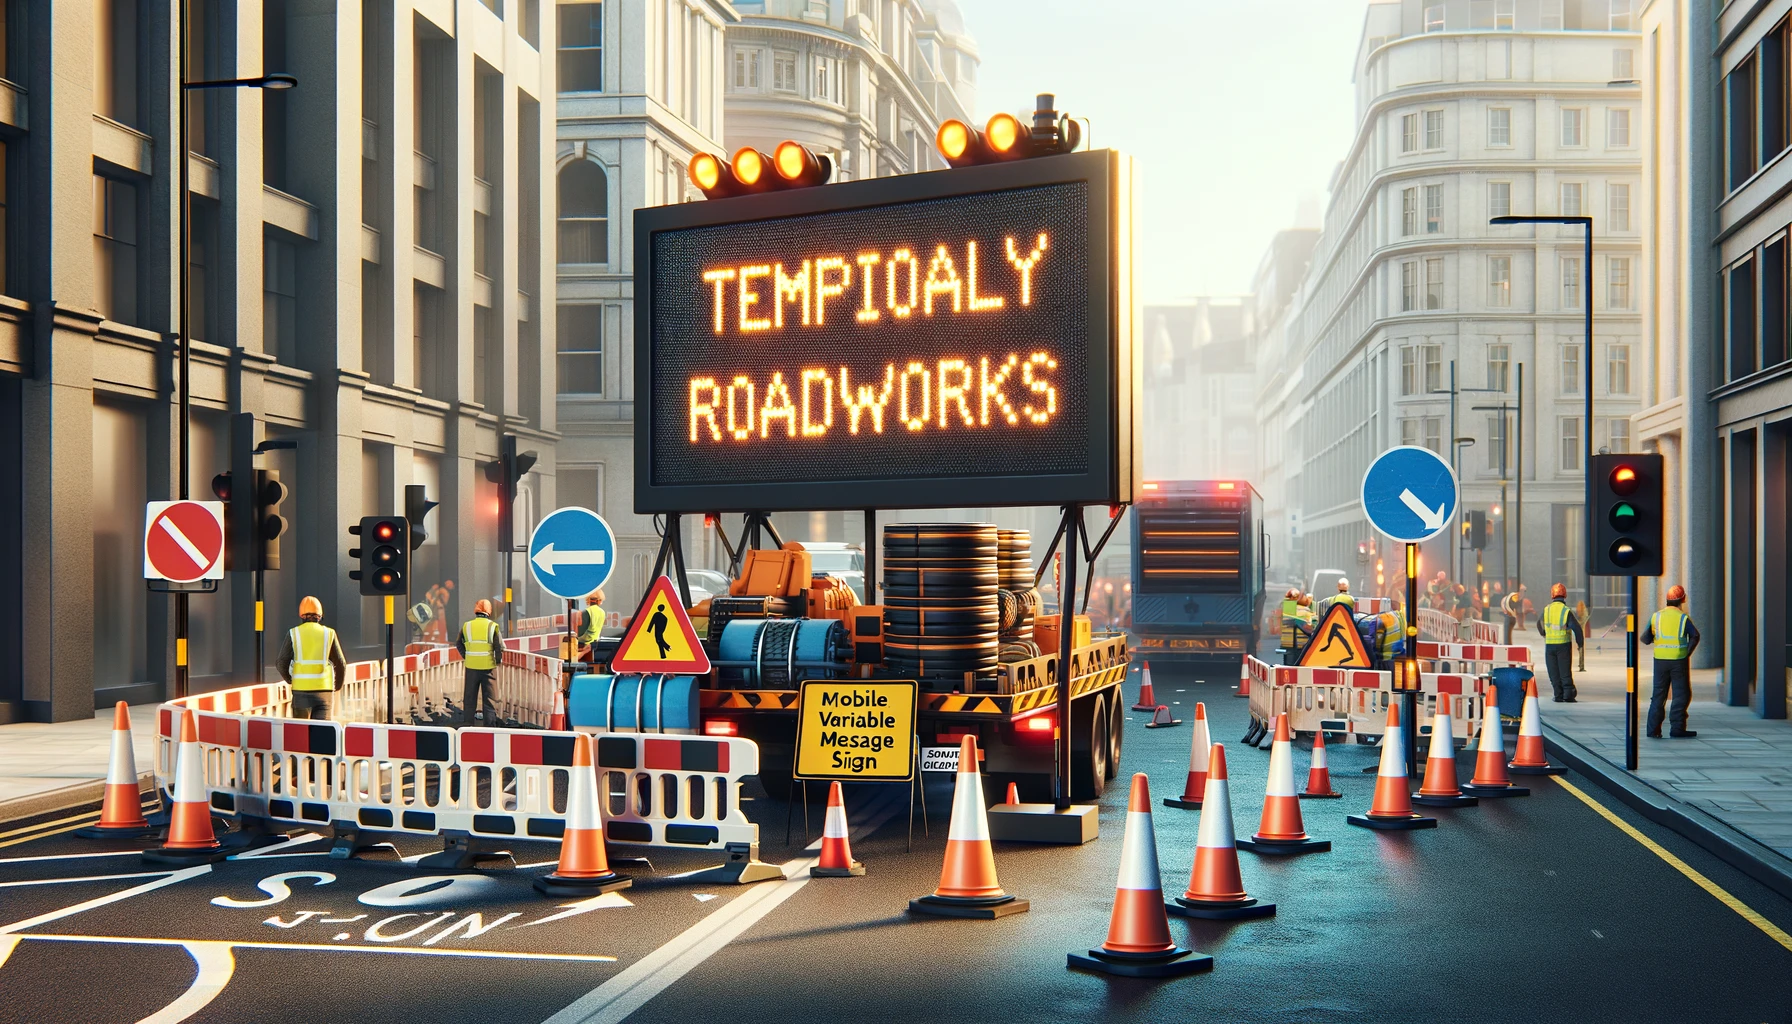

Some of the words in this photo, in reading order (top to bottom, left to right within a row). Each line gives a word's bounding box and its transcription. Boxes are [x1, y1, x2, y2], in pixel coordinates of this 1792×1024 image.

[702, 230, 1050, 335] TEMPIOALY
[688, 350, 1059, 443] ROADWORKS
[822, 690, 887, 707] Mobile
[819, 711, 895, 728] Variable
[820, 731, 894, 752] Mesage
